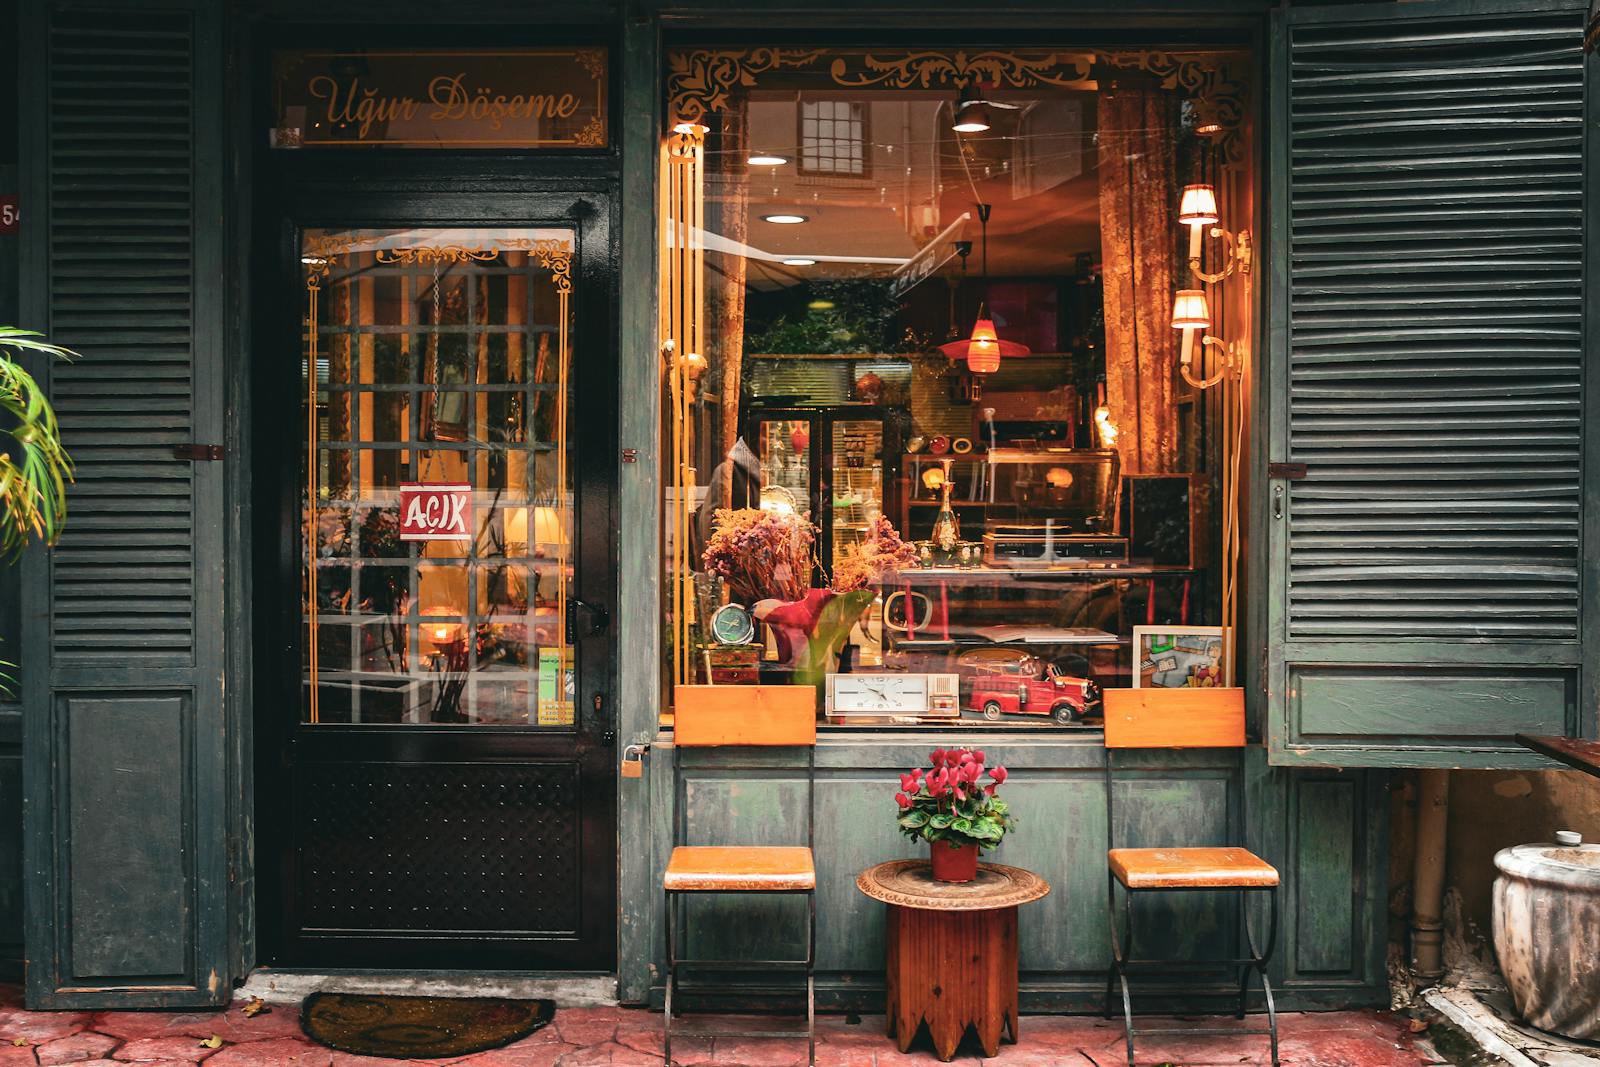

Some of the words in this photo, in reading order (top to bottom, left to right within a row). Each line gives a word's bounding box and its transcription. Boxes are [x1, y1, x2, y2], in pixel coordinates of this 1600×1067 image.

[309, 76, 421, 138] Uğur
[428, 73, 580, 130] Döşeme
[404, 493, 467, 534] AÇIK
